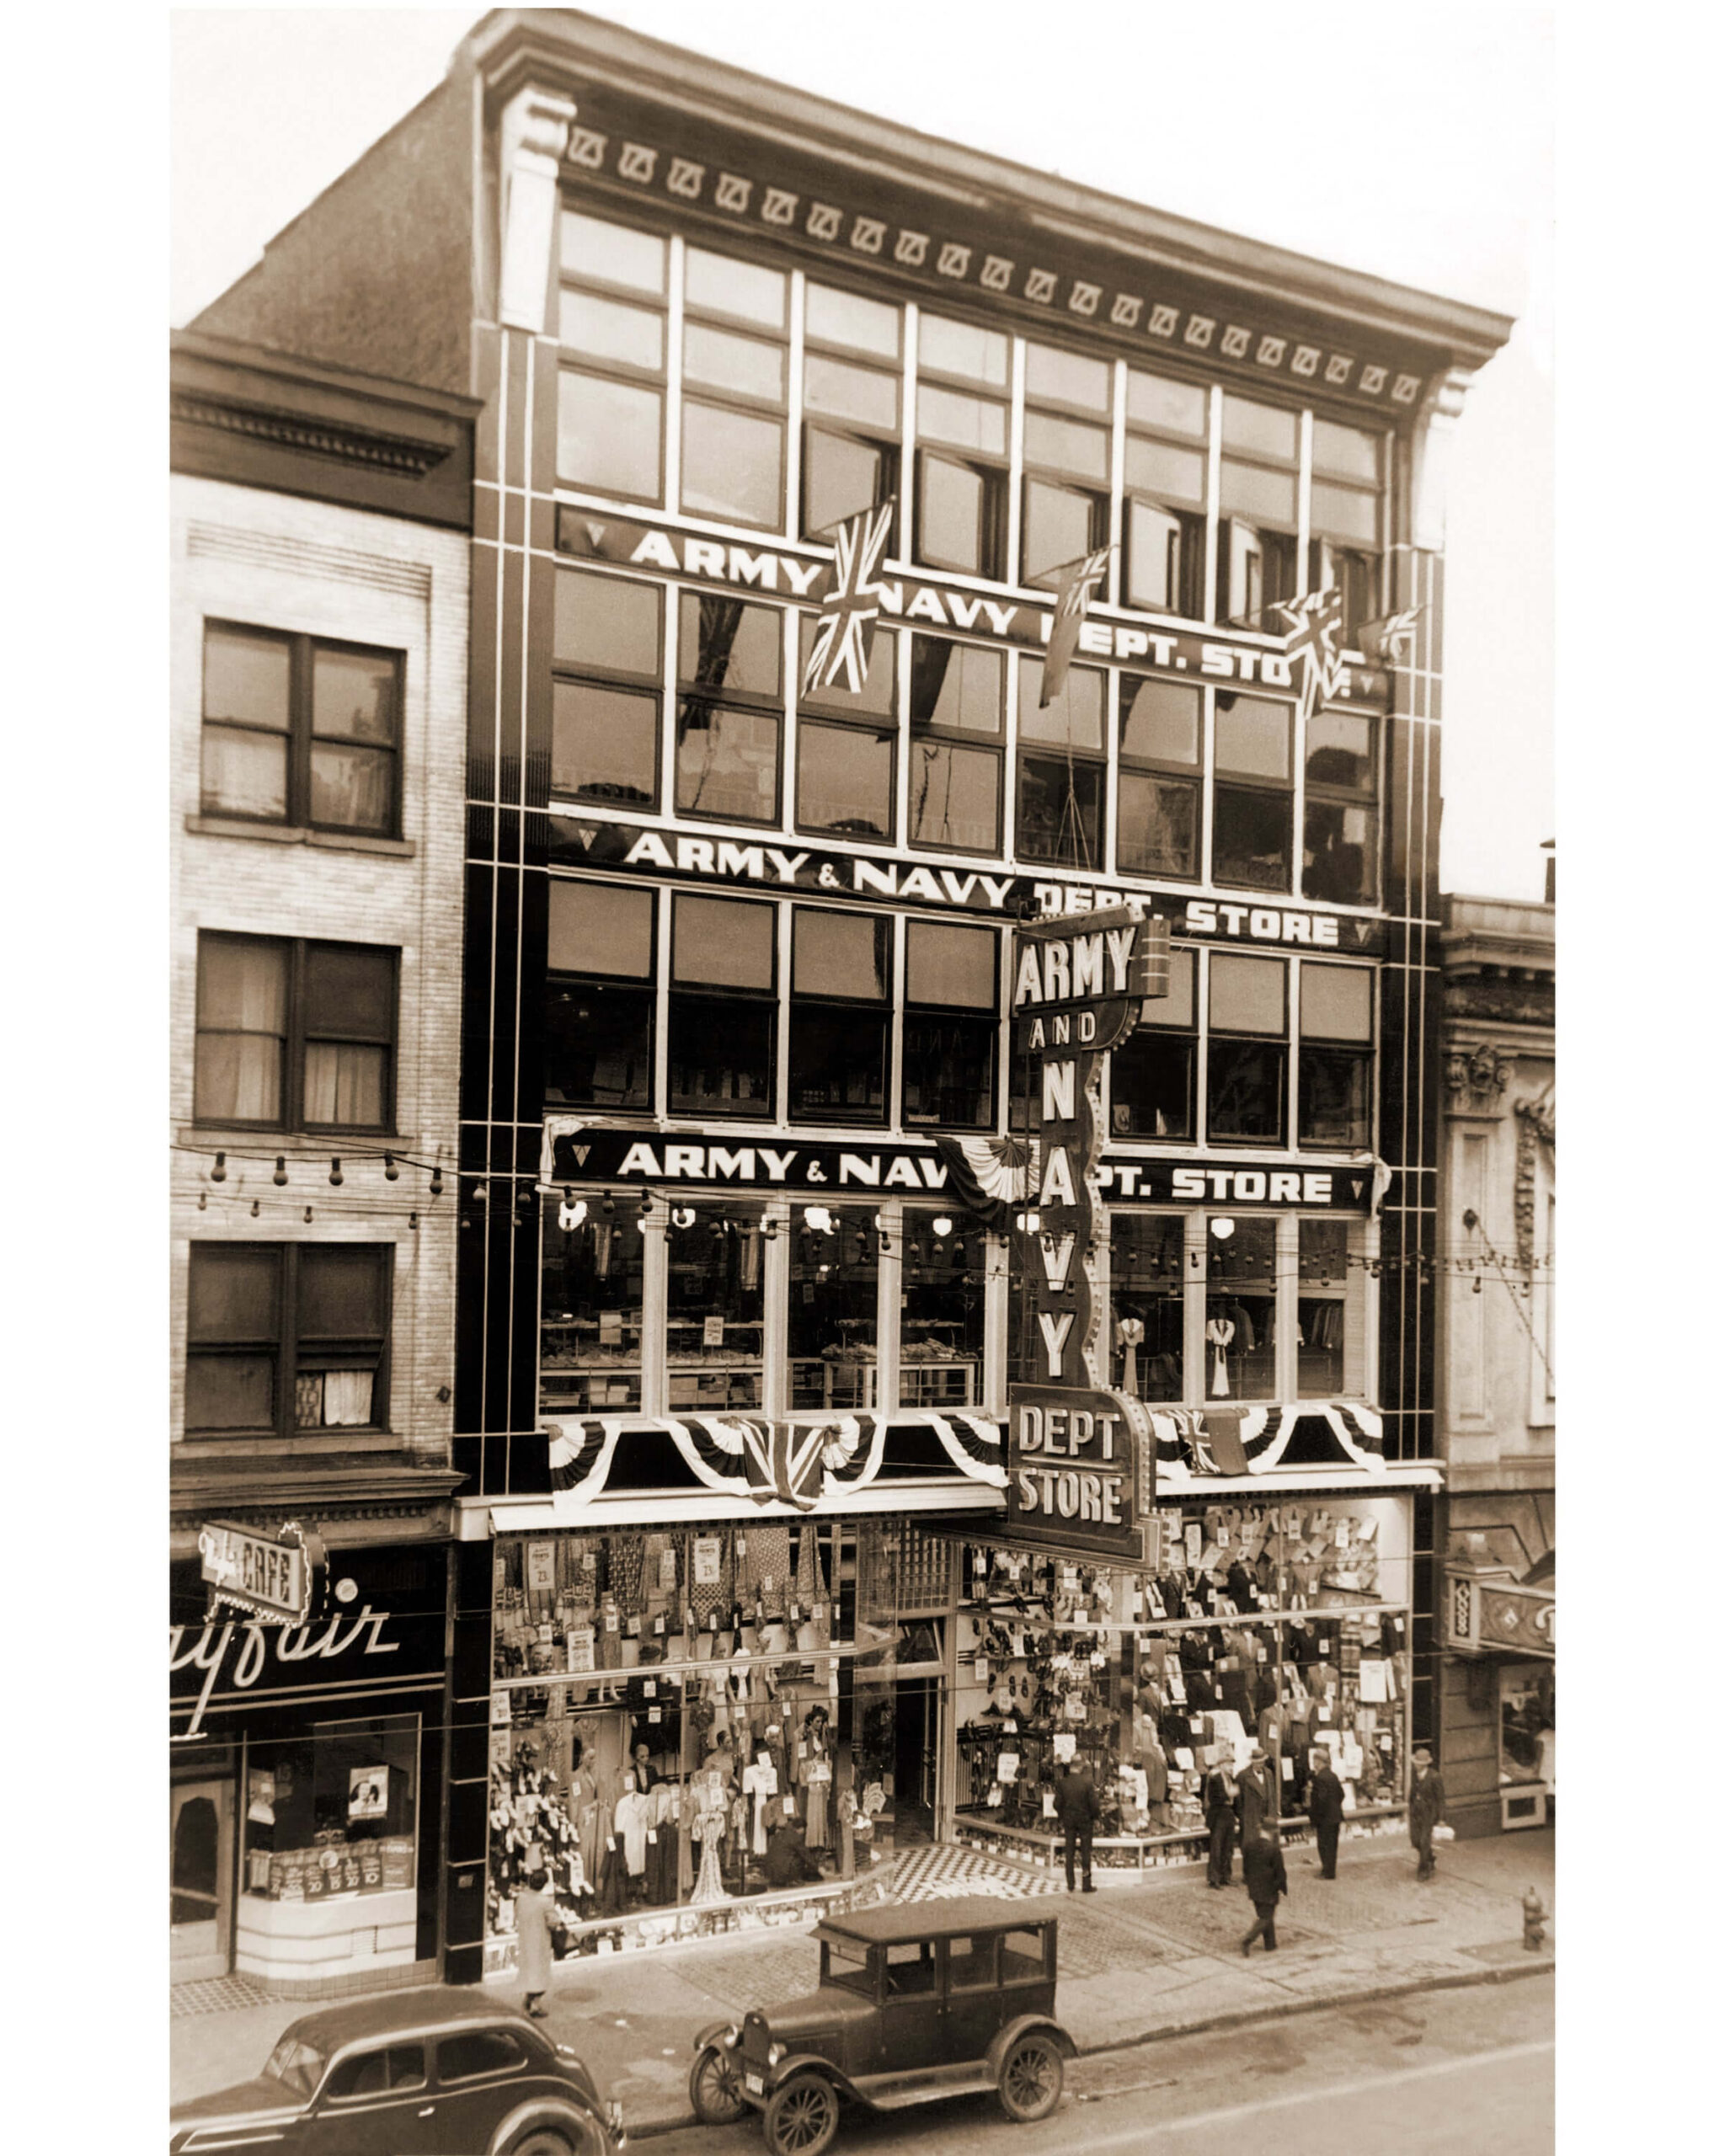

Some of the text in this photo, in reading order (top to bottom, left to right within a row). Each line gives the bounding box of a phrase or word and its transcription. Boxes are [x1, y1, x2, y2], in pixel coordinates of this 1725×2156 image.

[630, 531, 823, 595] ARMY
[1041, 612, 1187, 669] EPT.
[1201, 643, 1351, 698] STO
[626, 833, 809, 883] ARMY
[819, 863, 839, 887] &
[853, 861, 1014, 907] NAVY
[1186, 901, 1338, 945] STORE
[1014, 926, 1135, 1006] ARMY
[1029, 1011, 1097, 1049] AND
[618, 1144, 796, 1180] ARMY
[807, 1161, 826, 1182] &
[1172, 1169, 1332, 1203] STORE
[1039, 1061, 1076, 1378] NAVY
[1019, 1405, 1120, 1460] DEPT
[1017, 1467, 1122, 1524] STORE
[242, 1541, 291, 1603] CAFE
